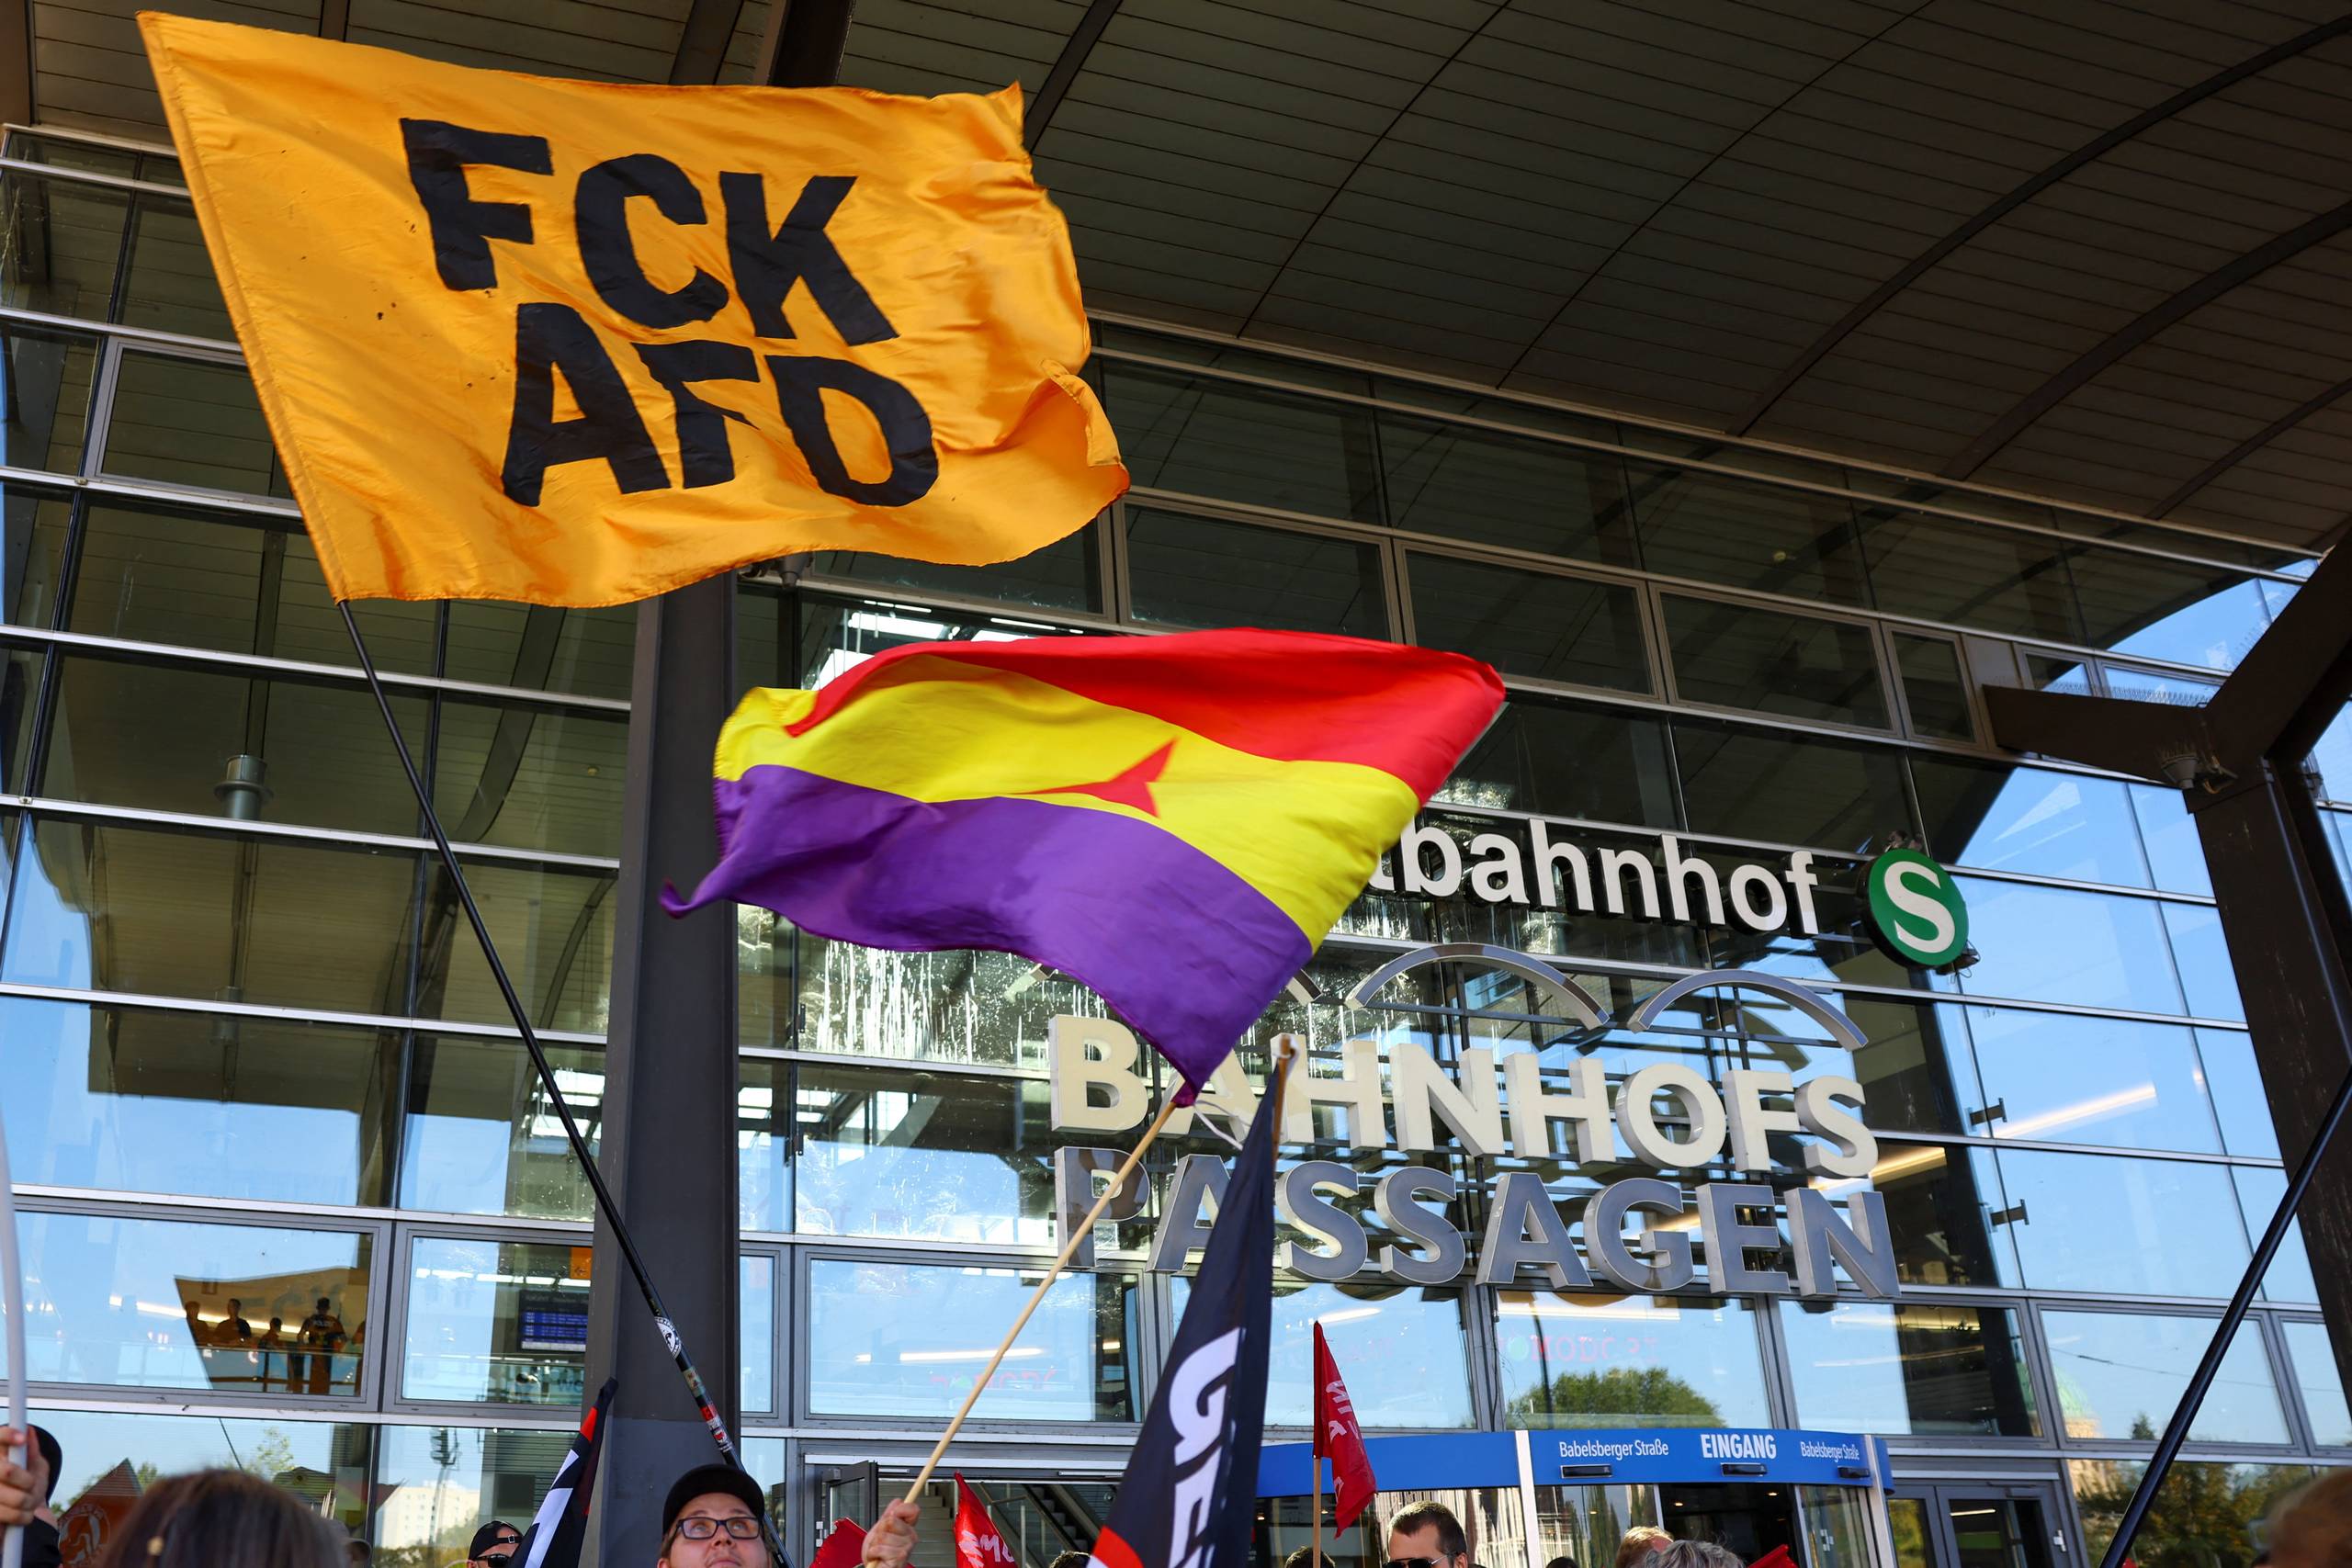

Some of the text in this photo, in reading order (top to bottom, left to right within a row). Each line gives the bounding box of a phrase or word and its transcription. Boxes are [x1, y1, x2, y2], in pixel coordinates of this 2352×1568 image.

[400, 118, 899, 346] FCK
[501, 302, 940, 507] AFD
[1883, 861, 1956, 953] S
[1048, 1013, 1879, 1178] BAHNHOFS
[1055, 1145, 1902, 1298] PASSAGEN
[1559, 1438, 1669, 1461] Babelsberger Straße
[1701, 1434, 1777, 1459] EINGANG
[1800, 1441, 1860, 1462] Babelsberger Straße
